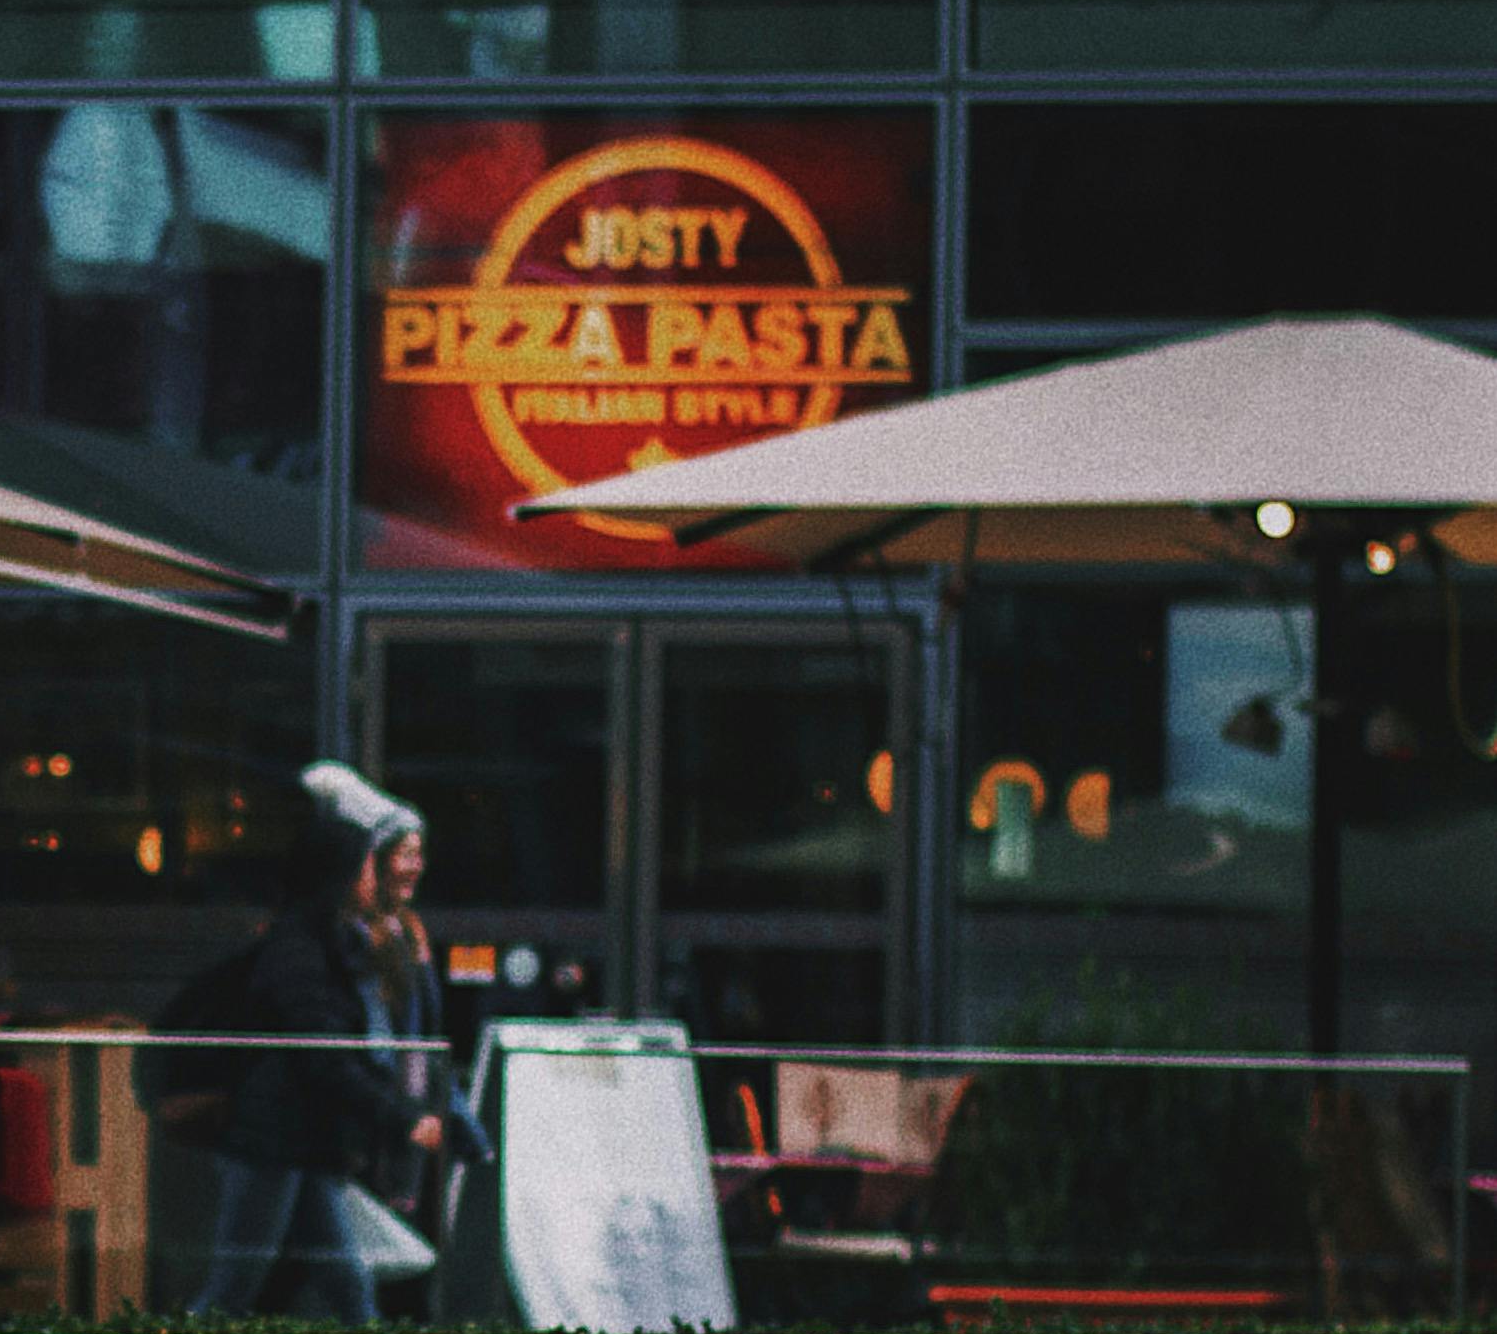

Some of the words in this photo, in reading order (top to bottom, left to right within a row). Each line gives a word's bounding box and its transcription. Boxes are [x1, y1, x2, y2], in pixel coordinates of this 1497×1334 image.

[564, 207, 748, 269] JOSTY
[383, 302, 625, 369] PIZZA
[645, 302, 911, 369] PASTA
[671, 387, 800, 426] STYLE
